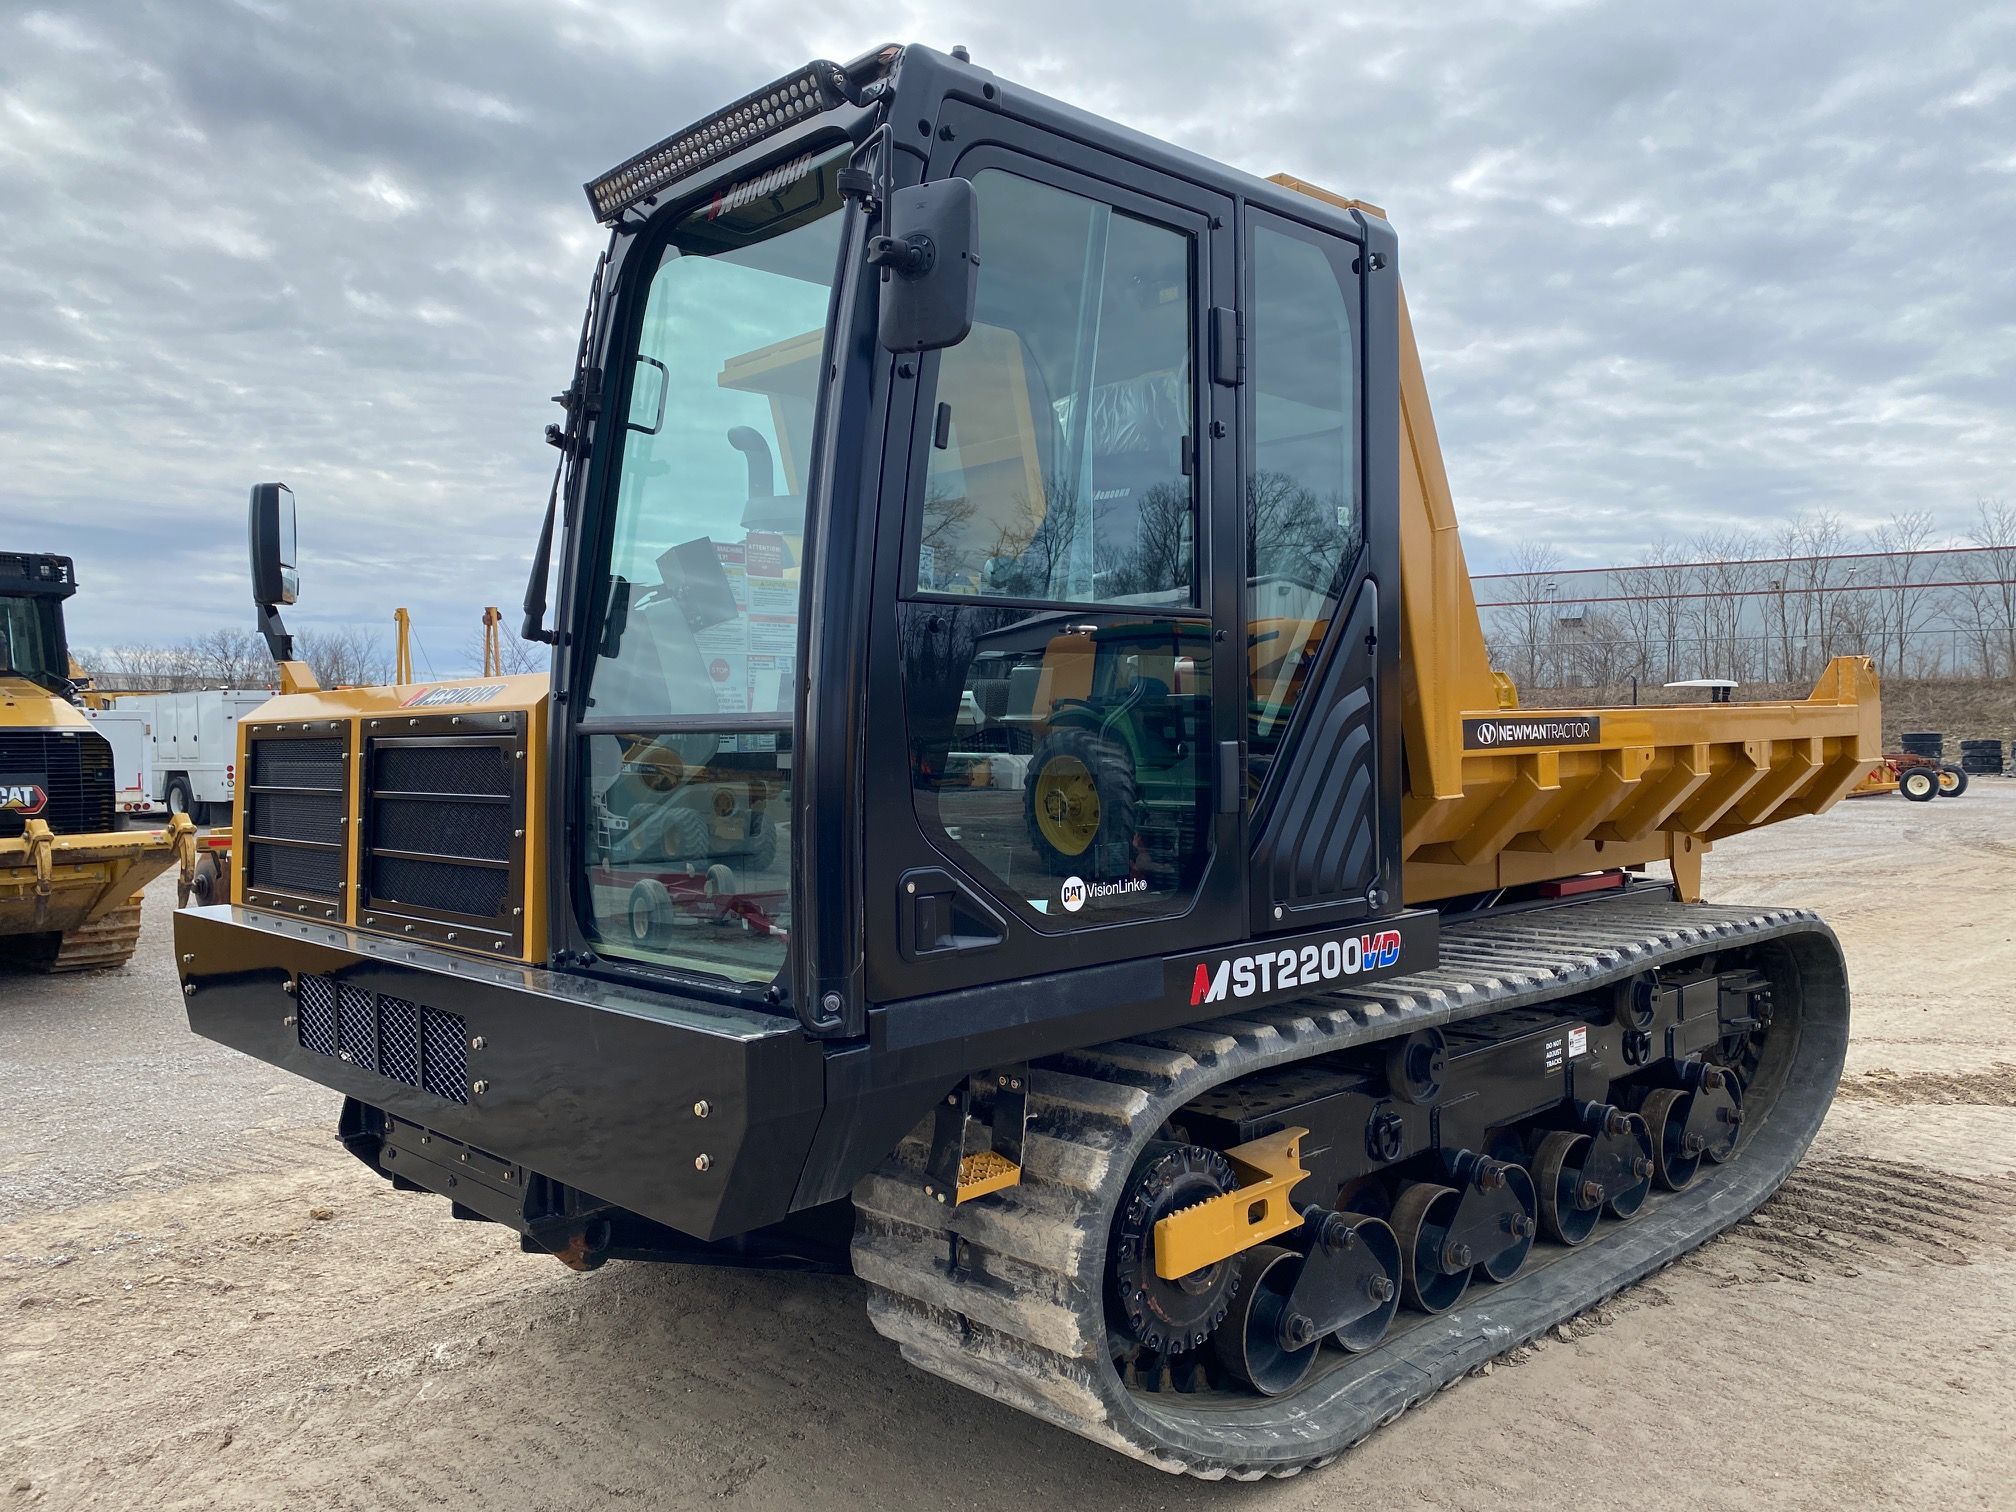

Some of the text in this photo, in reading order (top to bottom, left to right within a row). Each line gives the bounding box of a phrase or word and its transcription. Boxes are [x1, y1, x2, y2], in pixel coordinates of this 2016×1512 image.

[711, 666, 729, 674] STOP
[0, 786, 34, 808] CAT
[1063, 885, 1084, 903] CAT
[1190, 929, 1402, 1006] MST2200VD
[1552, 1039, 1562, 1048] NOT
[1546, 1048, 1562, 1058] ADJUST
[1546, 1057, 1562, 1067] TRACKS
